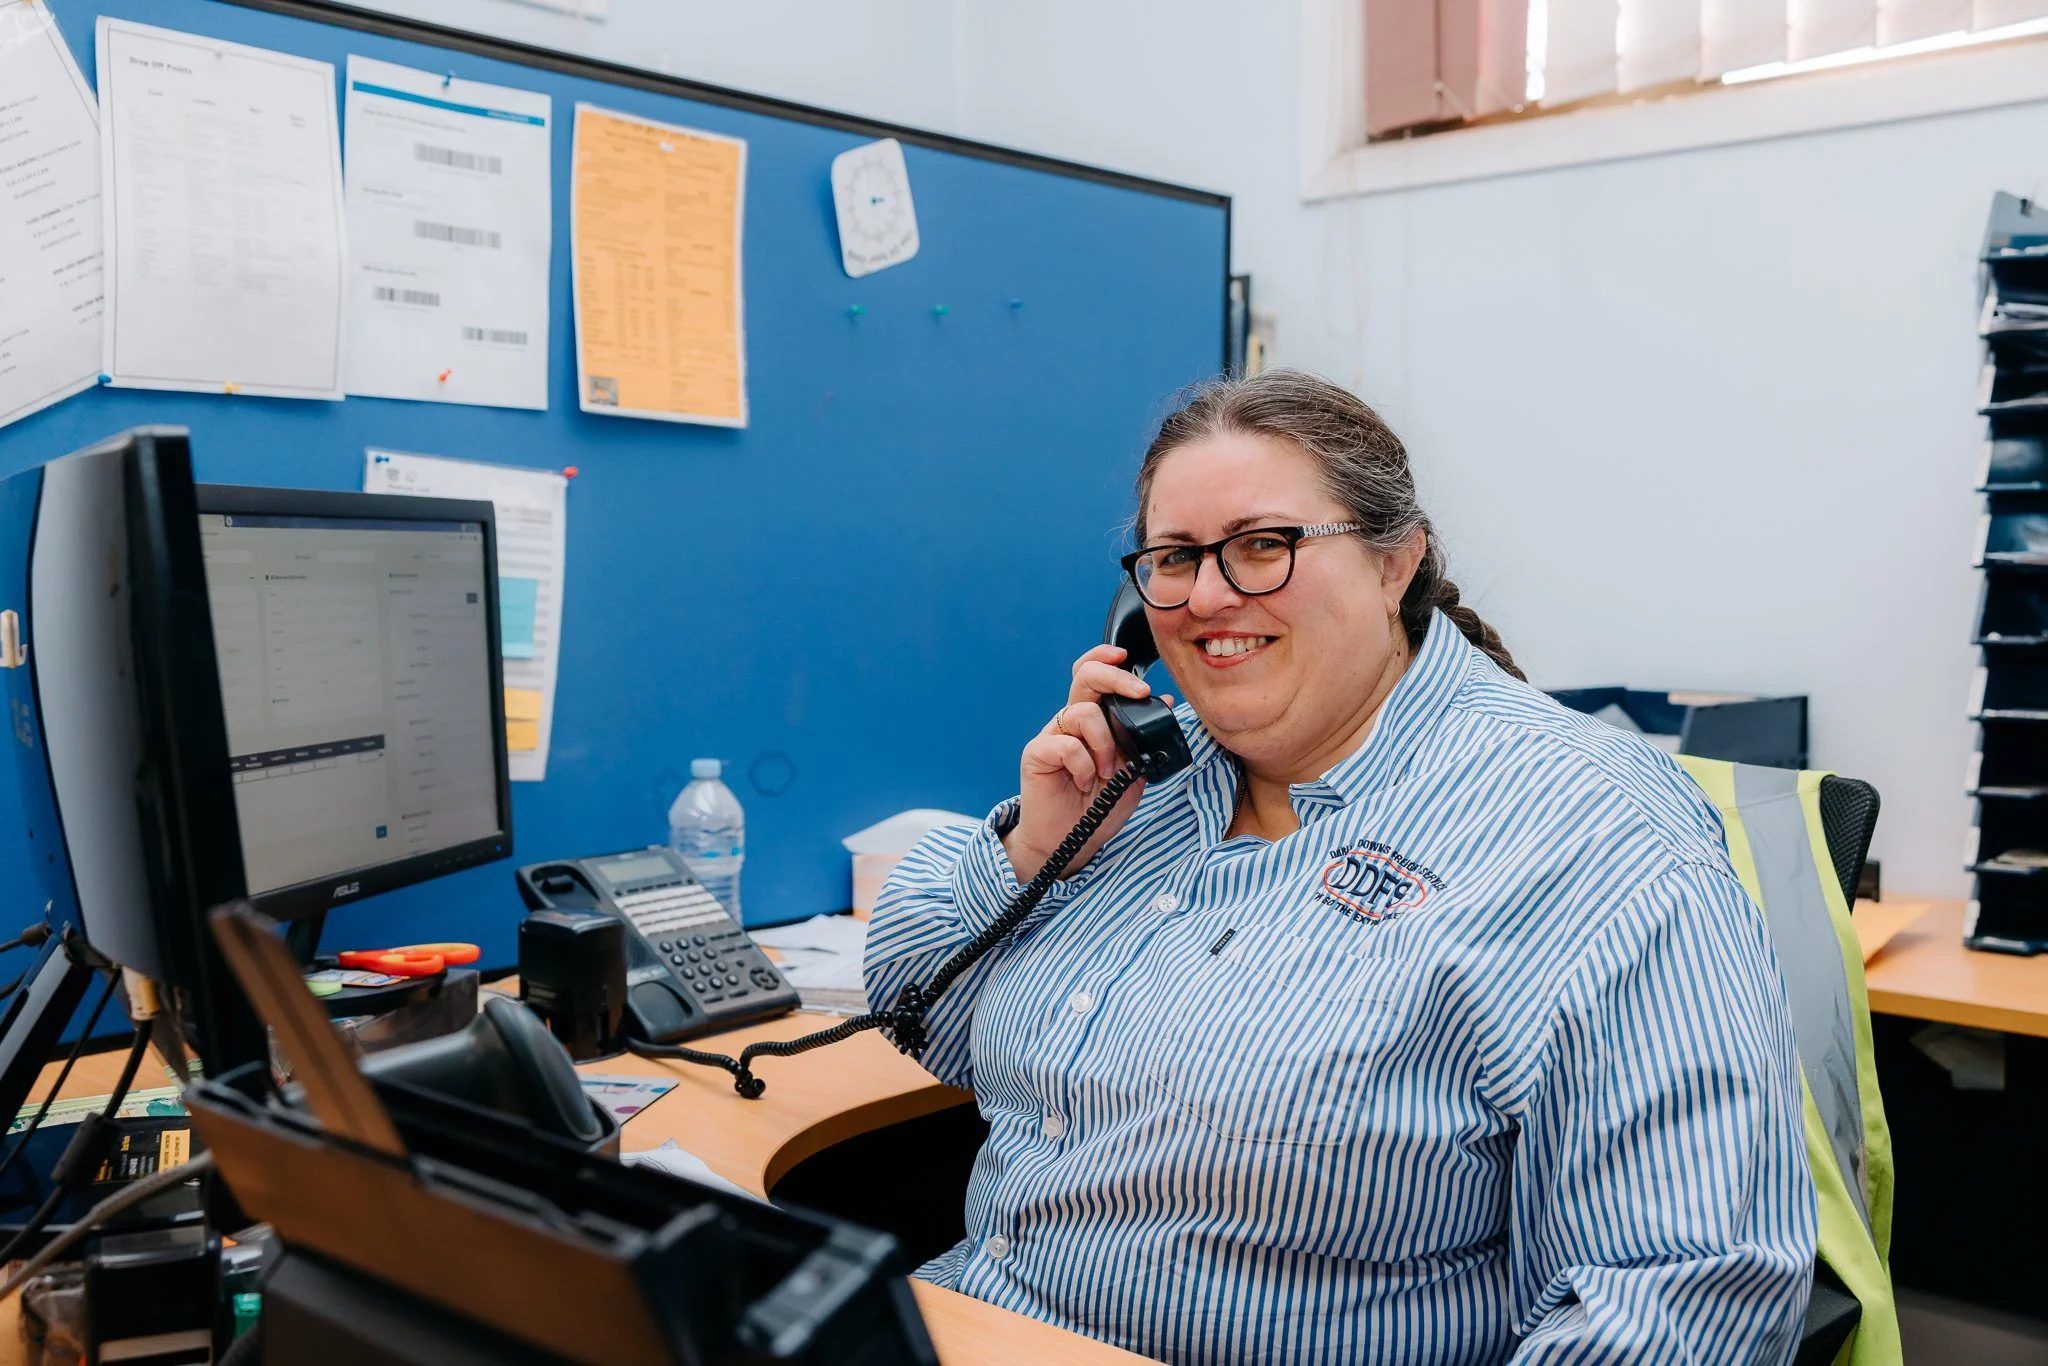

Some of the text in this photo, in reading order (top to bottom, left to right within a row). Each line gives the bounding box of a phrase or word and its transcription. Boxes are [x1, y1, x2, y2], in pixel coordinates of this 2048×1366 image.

[1357, 839, 1391, 854] DOWNS
[1391, 851, 1422, 872] FREIG
[333, 881, 360, 899] ASUS
[1329, 857, 1412, 908] DDFS
[1322, 896, 1335, 906] GO
[1335, 902, 1353, 917] THE
